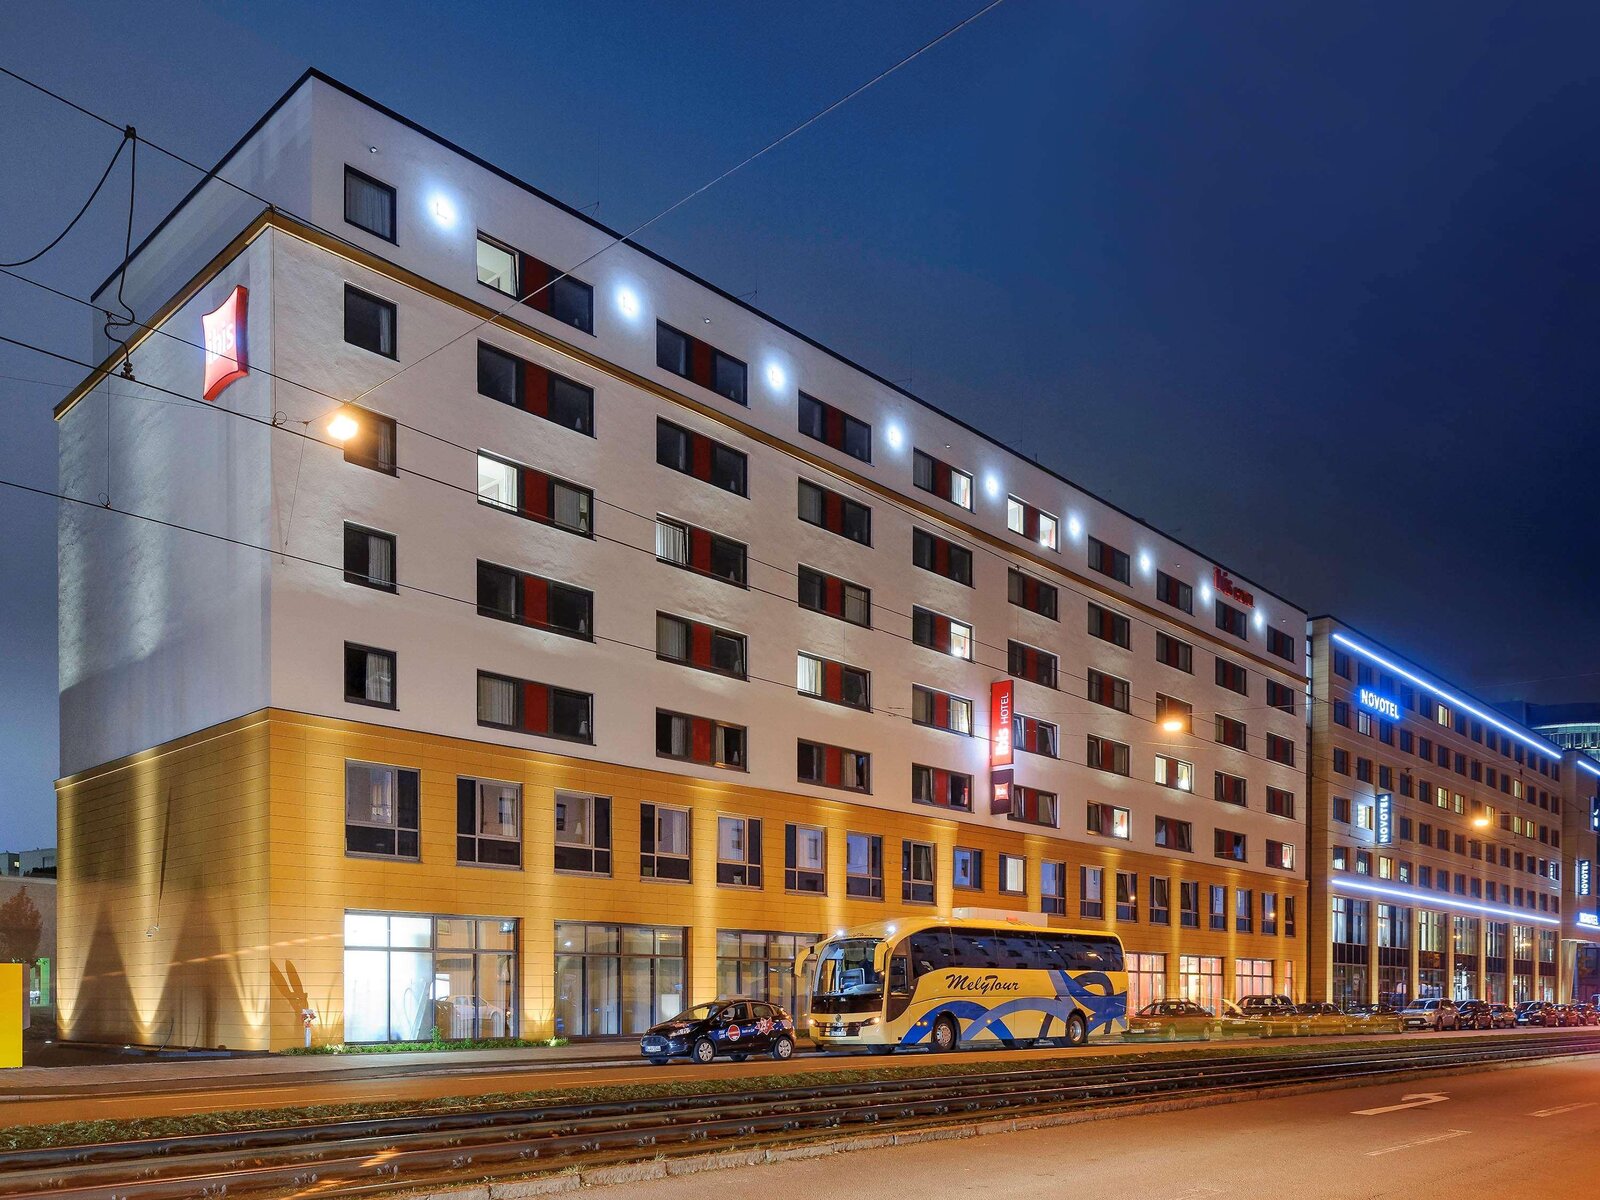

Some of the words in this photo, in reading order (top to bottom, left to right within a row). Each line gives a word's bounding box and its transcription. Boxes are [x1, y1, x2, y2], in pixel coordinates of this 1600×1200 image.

[1000, 692, 1009, 724] HOTEL
[1361, 689, 1399, 719] NOVOTEL
[1380, 795, 1389, 843] NOVOTEL
[1581, 861, 1589, 895] NOVOTEL
[945, 973, 1020, 995] MelyTour
